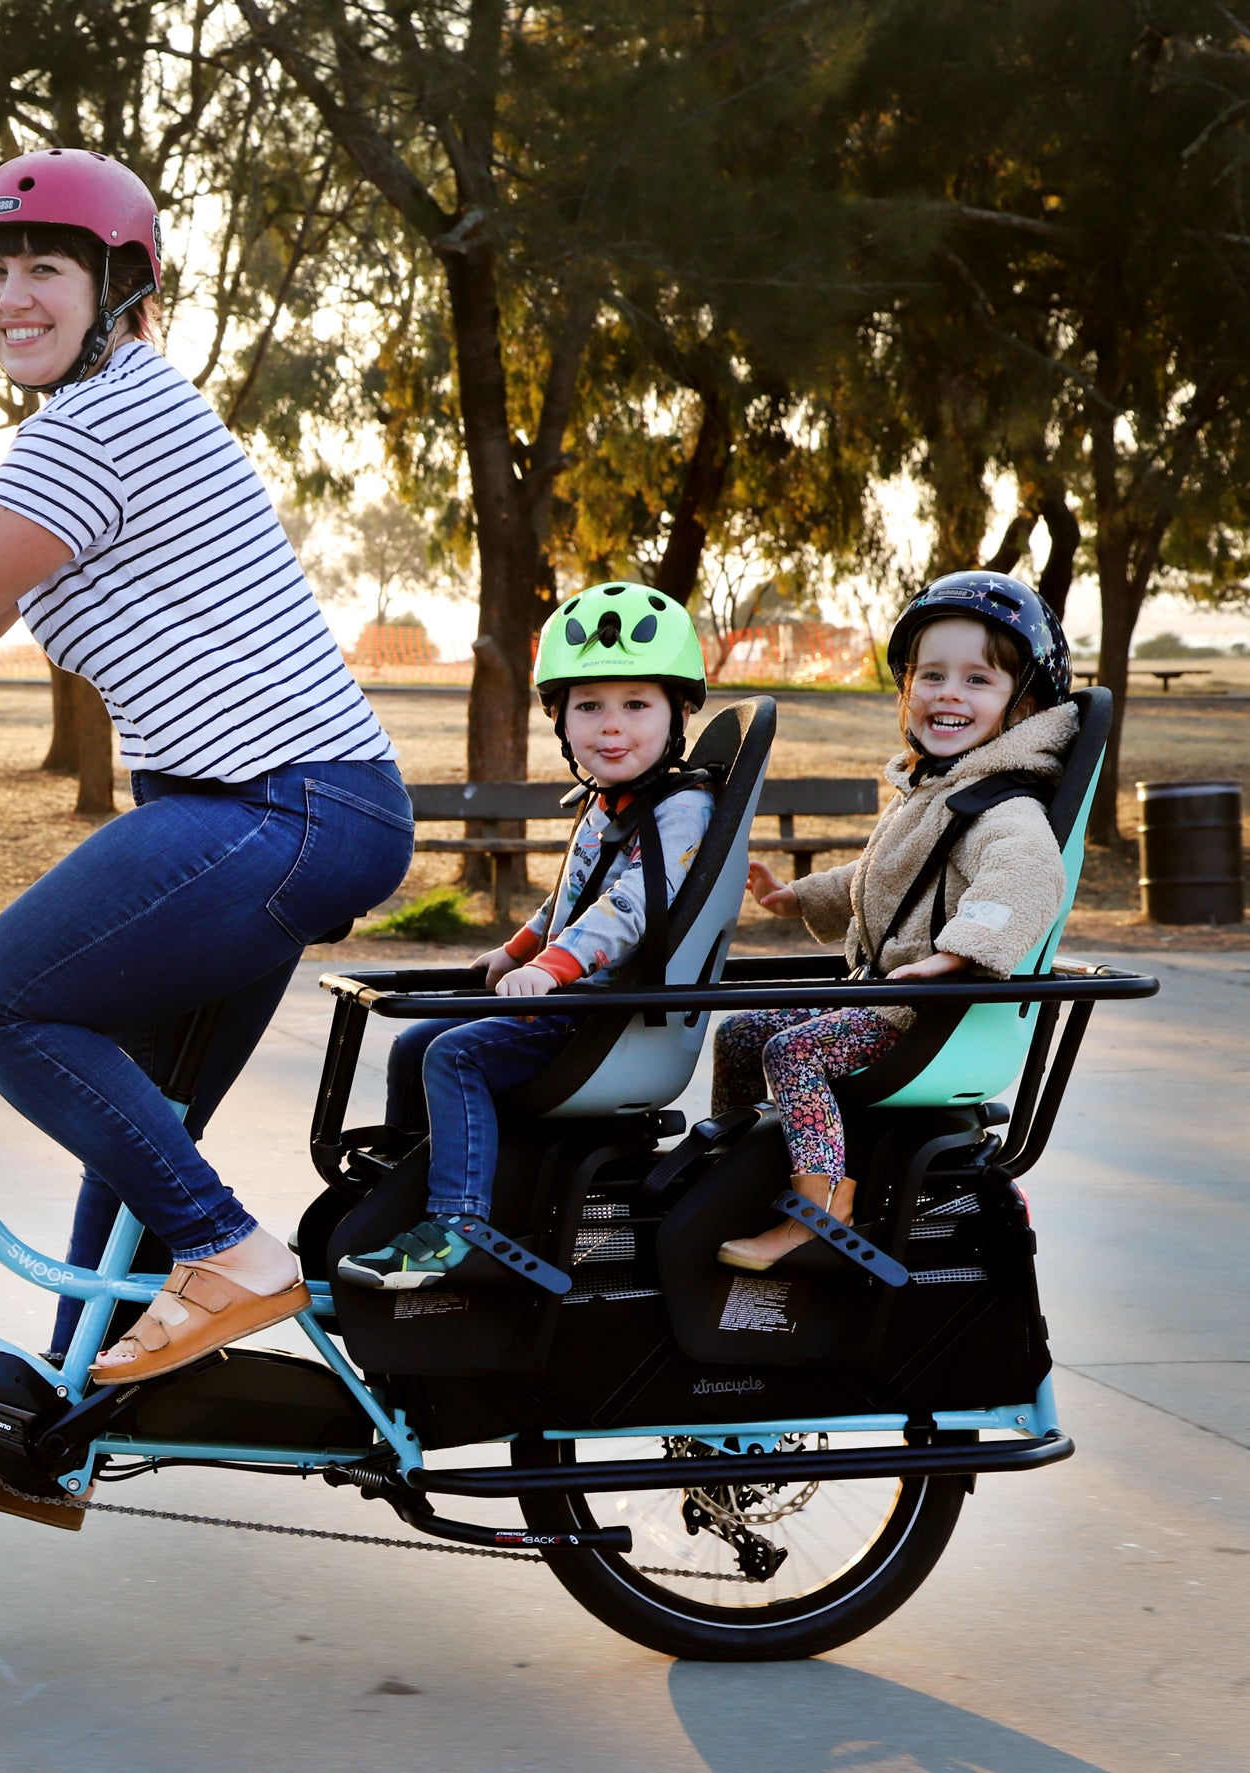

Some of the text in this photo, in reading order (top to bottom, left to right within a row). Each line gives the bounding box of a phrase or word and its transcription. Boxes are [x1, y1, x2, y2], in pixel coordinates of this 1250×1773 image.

[581, 659, 635, 669] BONTRAGER
[6, 1243, 75, 1285] SWOOP
[115, 1384, 141, 1405] SHIMAN
[692, 1375, 765, 1395] xtracycle
